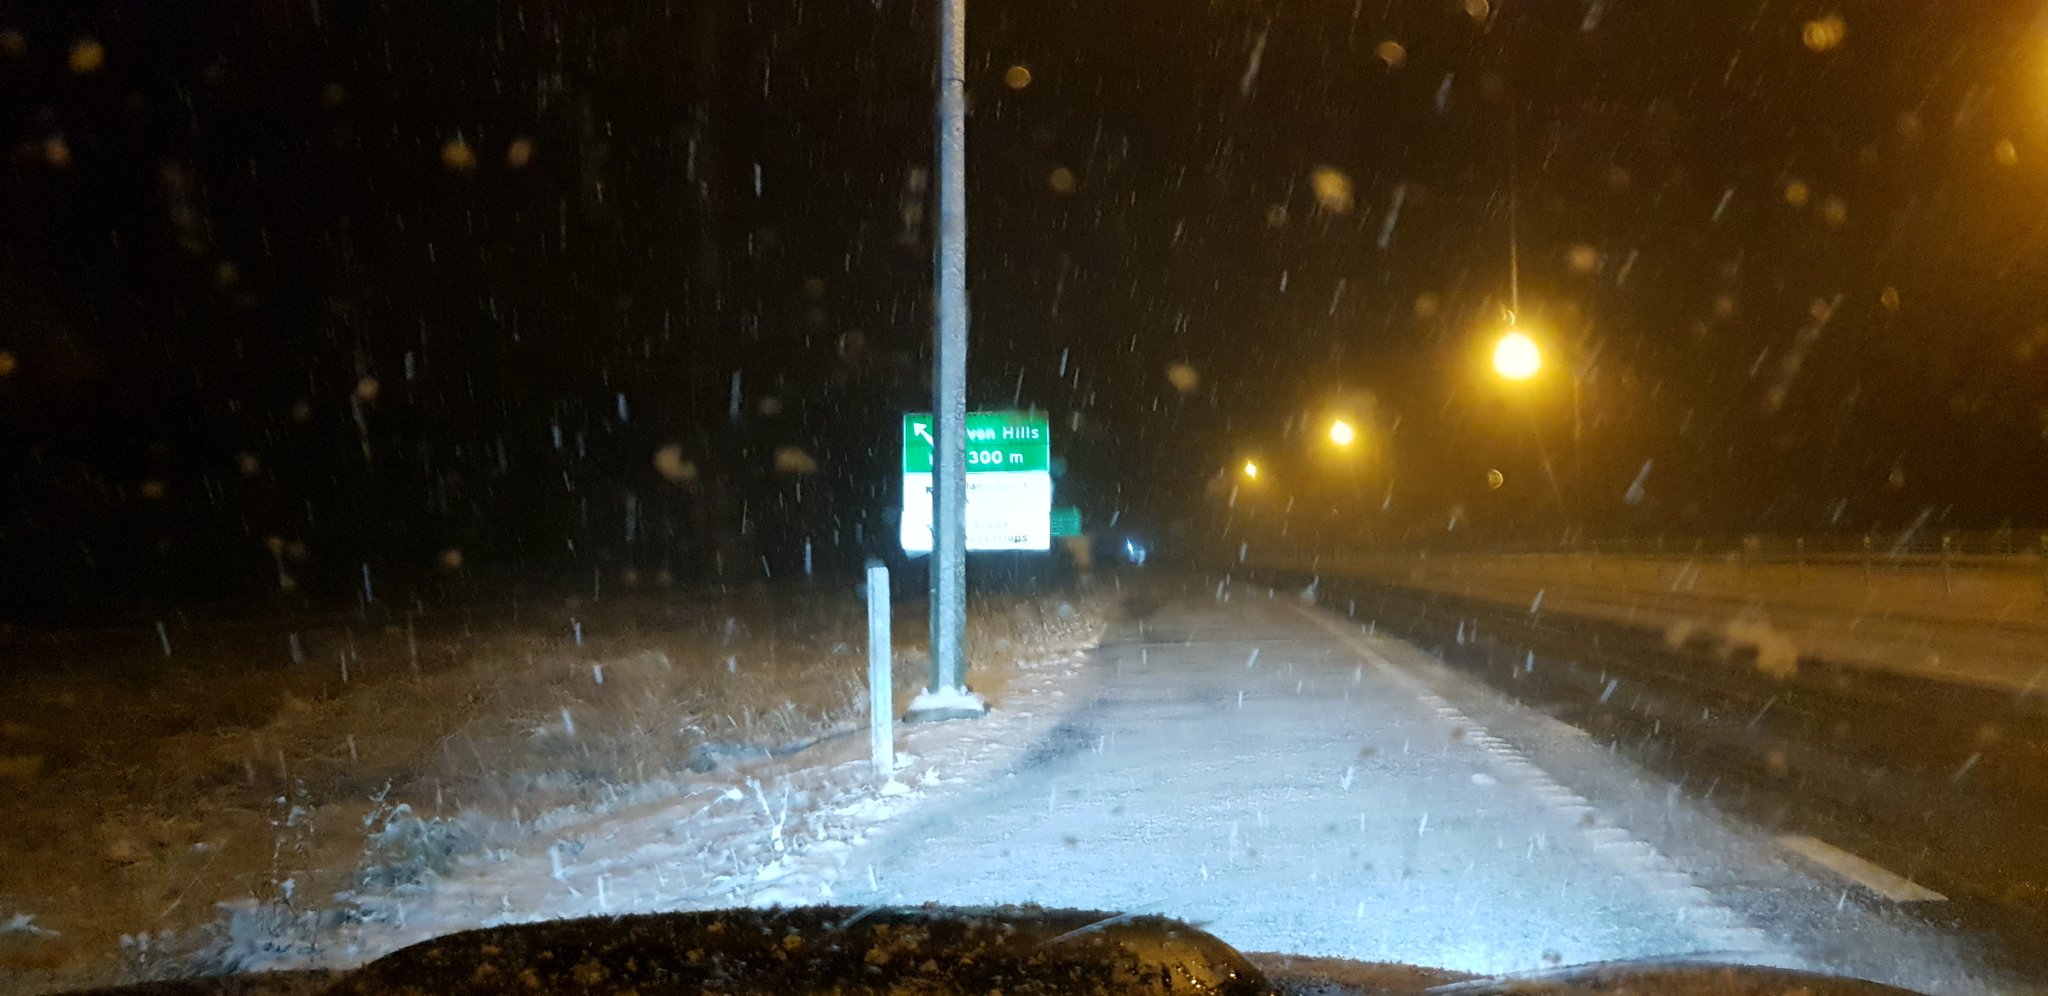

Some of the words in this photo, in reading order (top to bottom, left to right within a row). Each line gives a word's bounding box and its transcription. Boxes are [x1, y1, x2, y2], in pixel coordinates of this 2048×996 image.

[966, 428, 996, 440] ven
[1003, 426, 1039, 439] Hills
[968, 450, 1003, 464] 300
[1009, 453, 1024, 464] m
